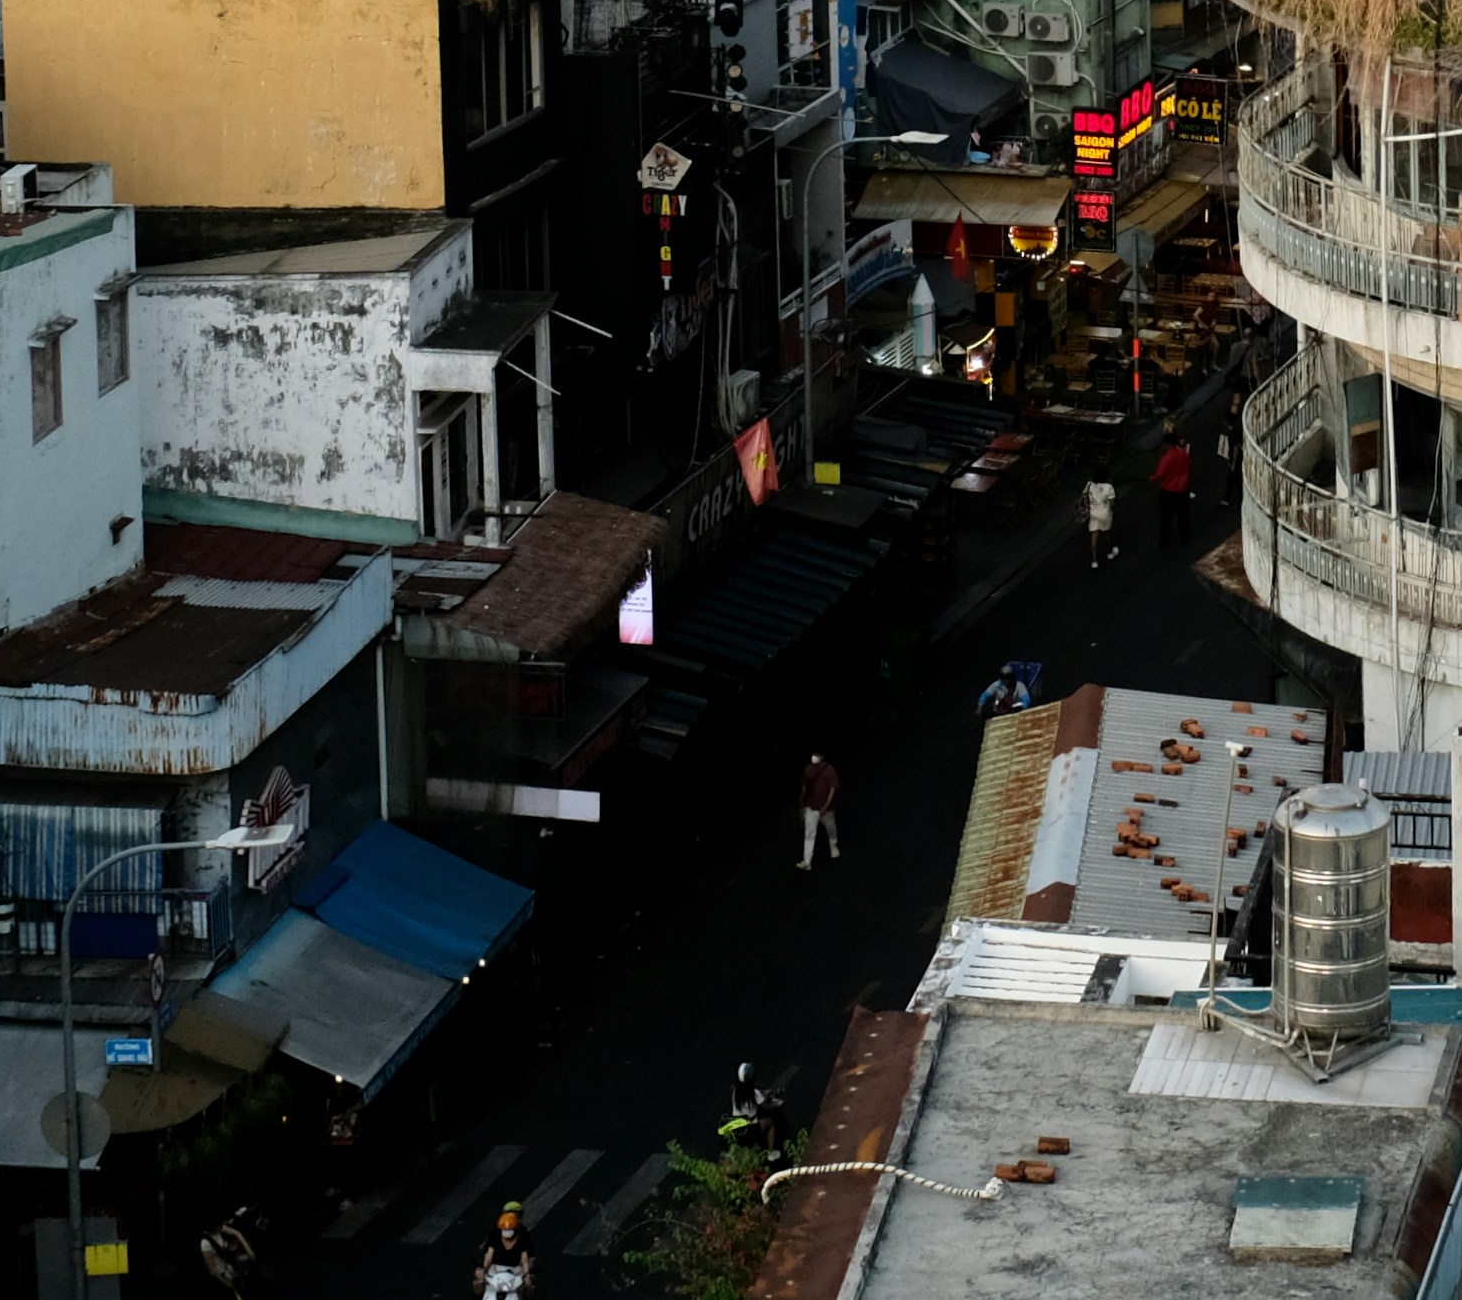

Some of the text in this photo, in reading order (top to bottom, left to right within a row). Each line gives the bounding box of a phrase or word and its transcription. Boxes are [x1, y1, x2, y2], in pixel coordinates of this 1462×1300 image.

[1073, 112, 1115, 134] BBQ
[1074, 134, 1115, 148] SAIGON
[1076, 147, 1111, 160] NIGHT
[646, 166, 678, 181] Tiger
[642, 193, 688, 217] CRAZY
